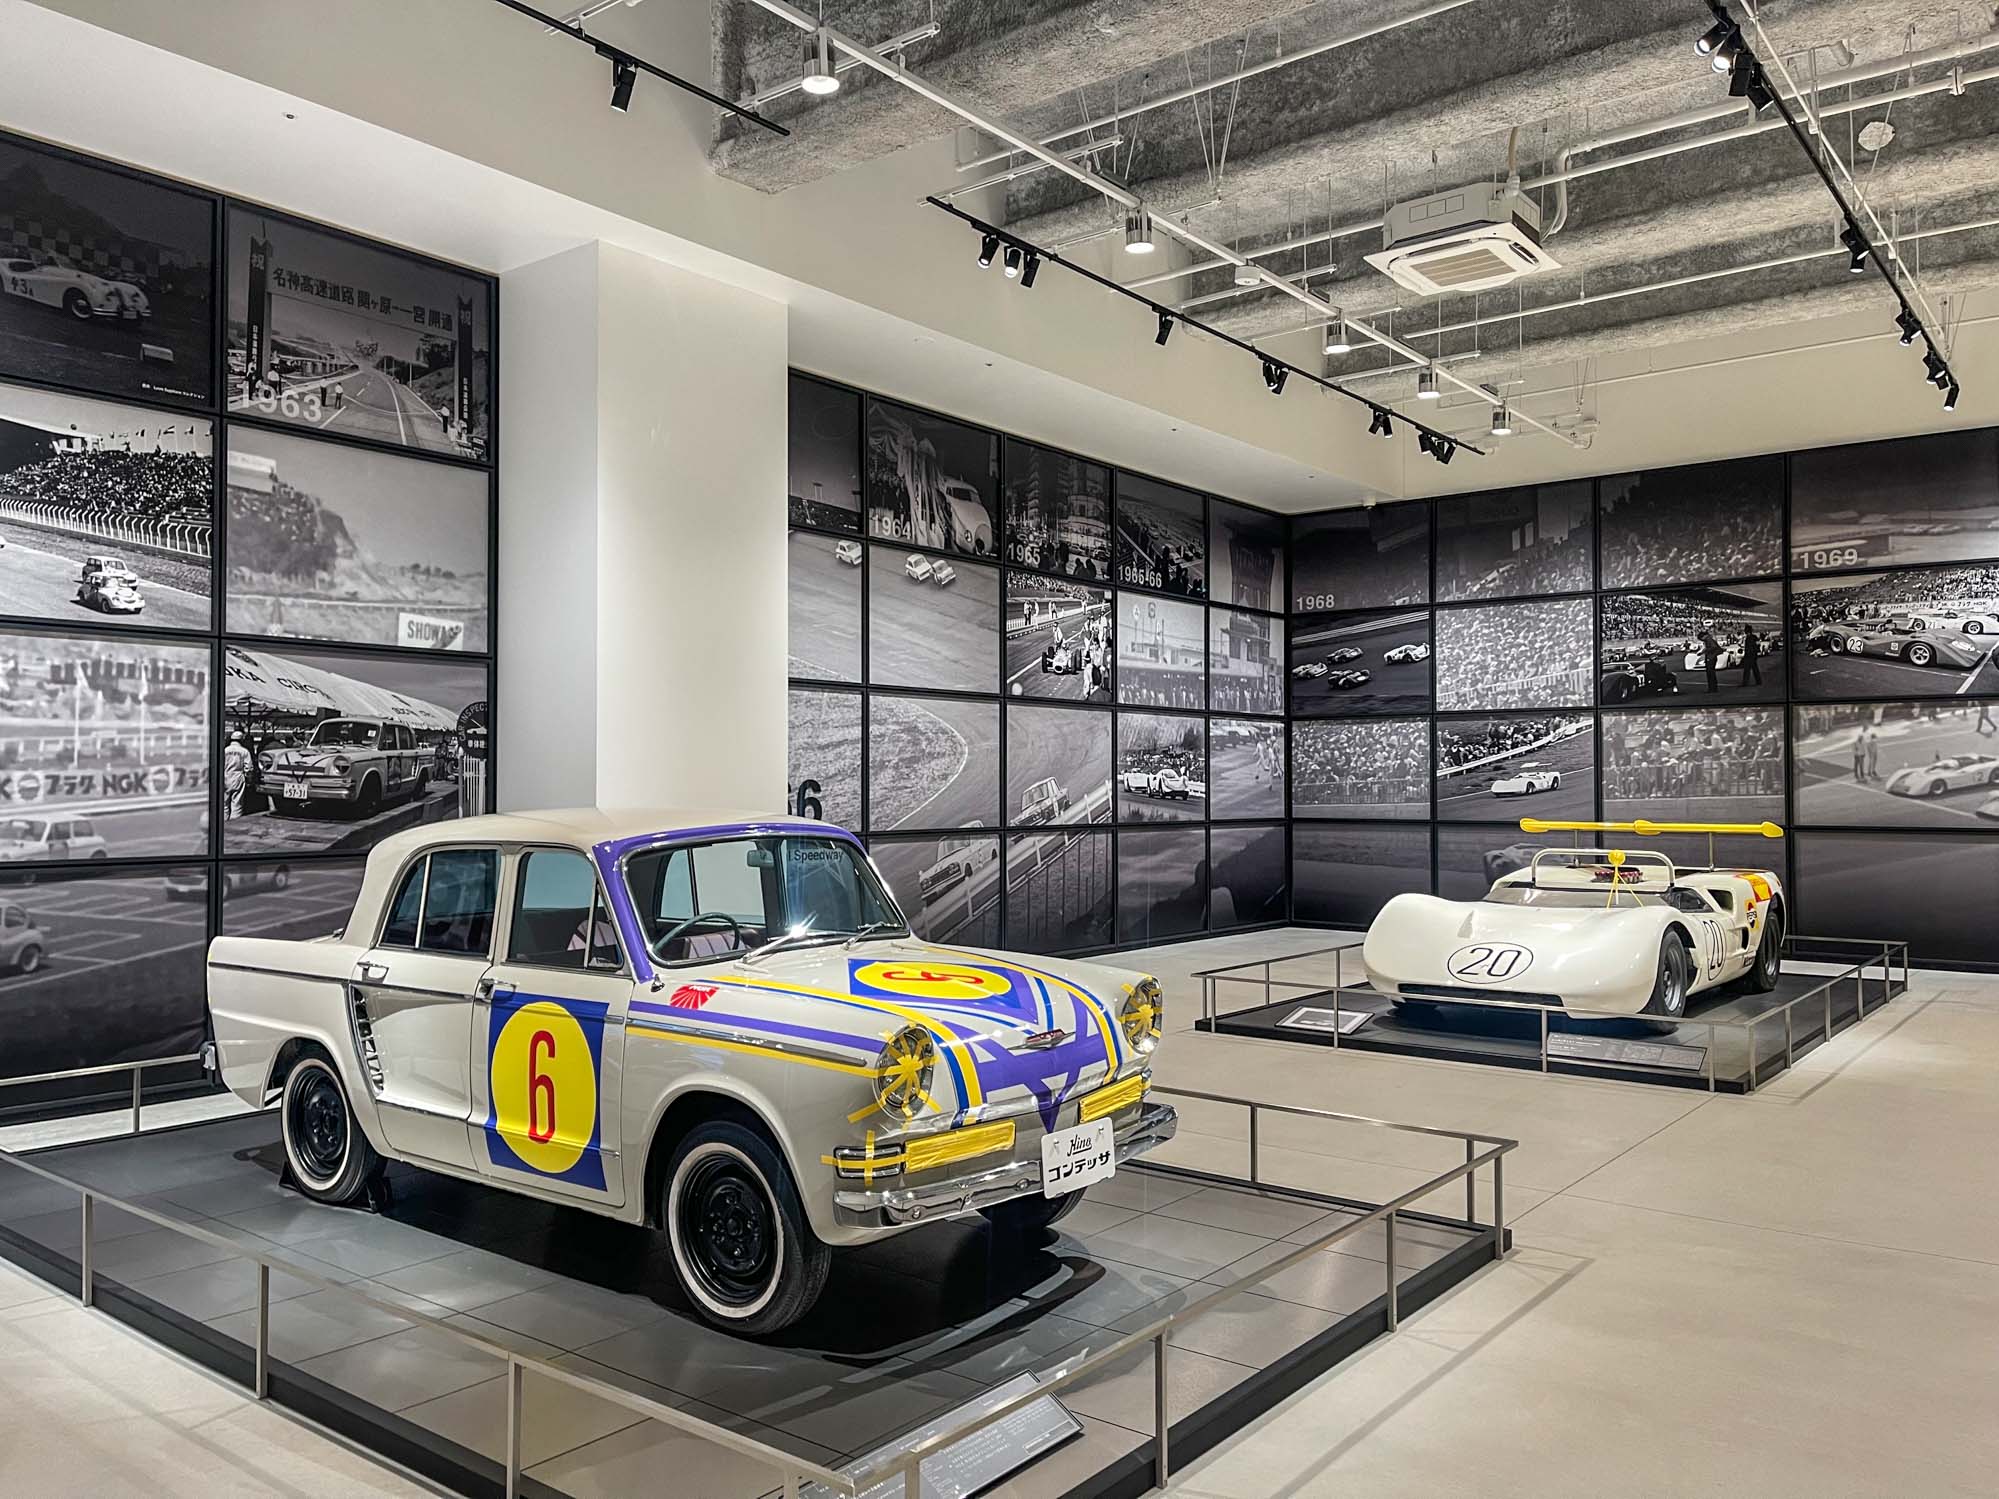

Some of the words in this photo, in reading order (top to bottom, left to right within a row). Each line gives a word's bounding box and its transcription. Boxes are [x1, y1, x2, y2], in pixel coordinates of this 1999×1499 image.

[237, 380, 322, 422] 1963
[871, 513, 911, 540] 1964
[1008, 543, 1040, 565] 1965
[1800, 548, 1858, 569] 1969
[1297, 594, 1335, 611] 1968
[1849, 638, 1864, 652] 23
[102, 772, 149, 795] NGK
[794, 849, 844, 863] Speedway
[1456, 947, 1522, 977] 20
[528, 1030, 556, 1144] 6
[1066, 1134, 1092, 1157] Hino
[1048, 1150, 1111, 1183] コンテッサ
